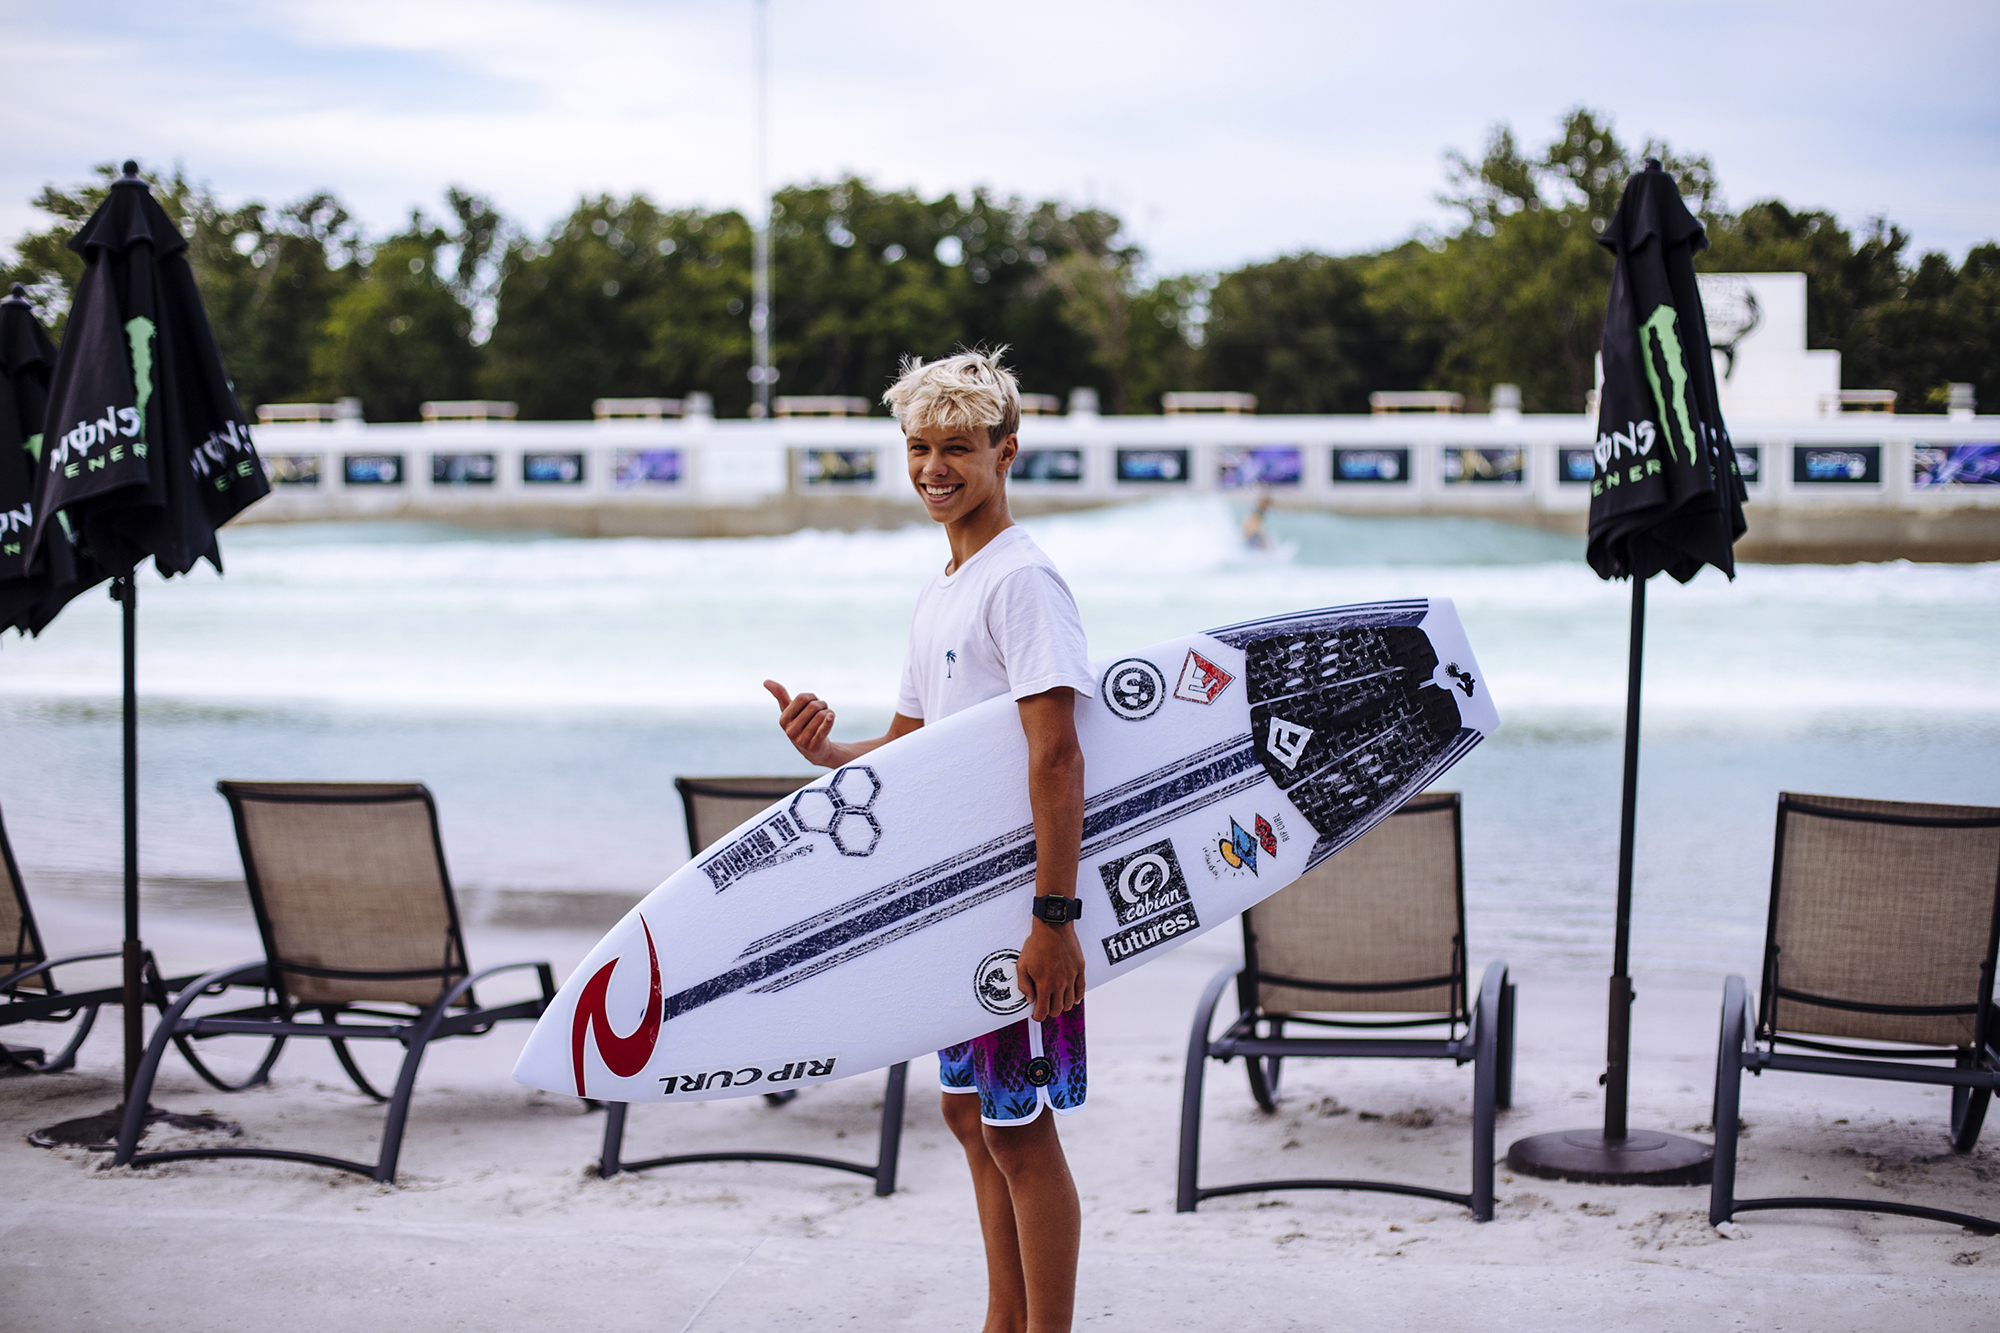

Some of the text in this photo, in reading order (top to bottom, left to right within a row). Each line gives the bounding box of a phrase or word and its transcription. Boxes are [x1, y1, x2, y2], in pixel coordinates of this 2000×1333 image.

[49, 405, 141, 473] MONS
[64, 443, 148, 479] ENER
[1591, 458, 1662, 498] ENER
[1272, 812, 1291, 843] RIP CURL
[702, 814, 797, 889] AL MERRICK
[1126, 888, 1181, 921] cobian
[1108, 913, 1196, 959] futures.
[658, 1057, 837, 1095] RIP CURL
